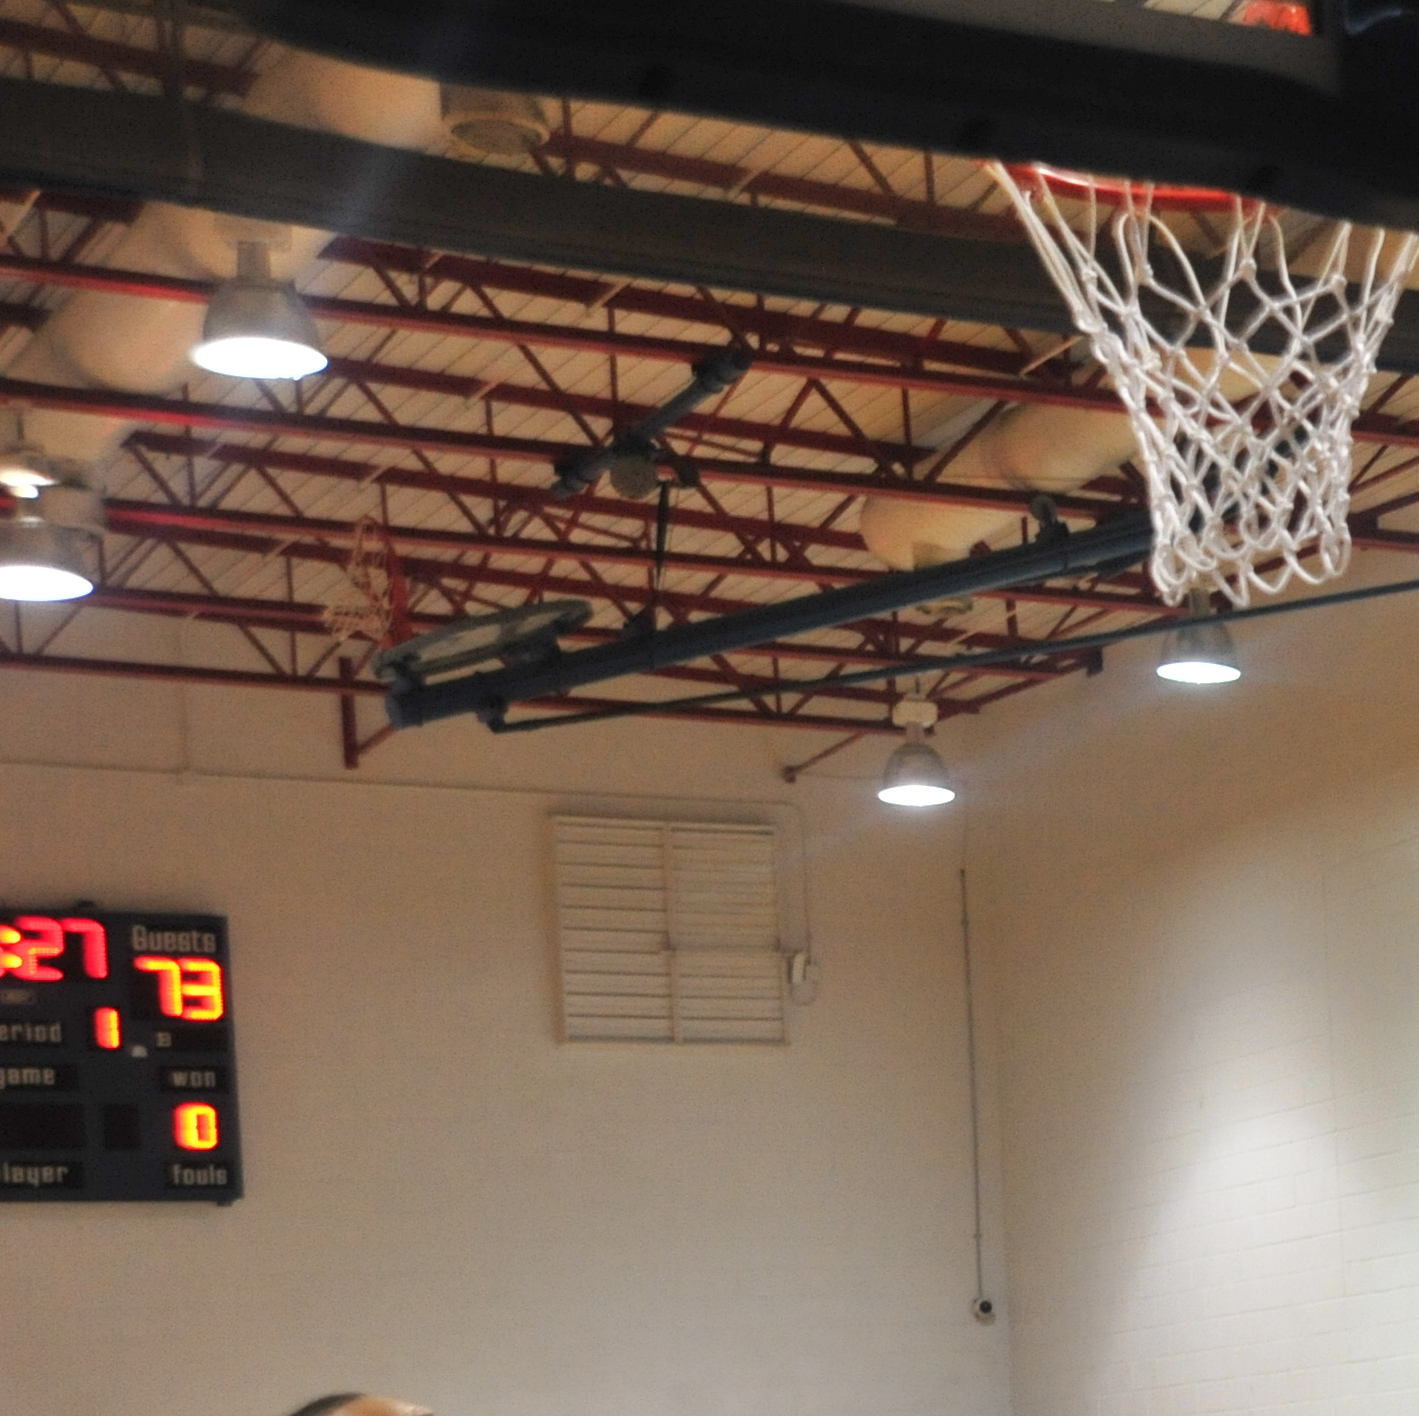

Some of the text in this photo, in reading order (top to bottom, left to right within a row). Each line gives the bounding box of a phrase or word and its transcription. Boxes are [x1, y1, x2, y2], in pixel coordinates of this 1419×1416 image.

[131, 925, 217, 953] Guests
[134, 956, 224, 1022] 73
[0, 1021, 63, 1043] eriod
[94, 1006, 121, 1050] 1
[172, 1070, 216, 1088] won
[174, 1102, 220, 1150] 0
[3, 1162, 69, 1187] layer
[173, 1163, 228, 1186] fouls
